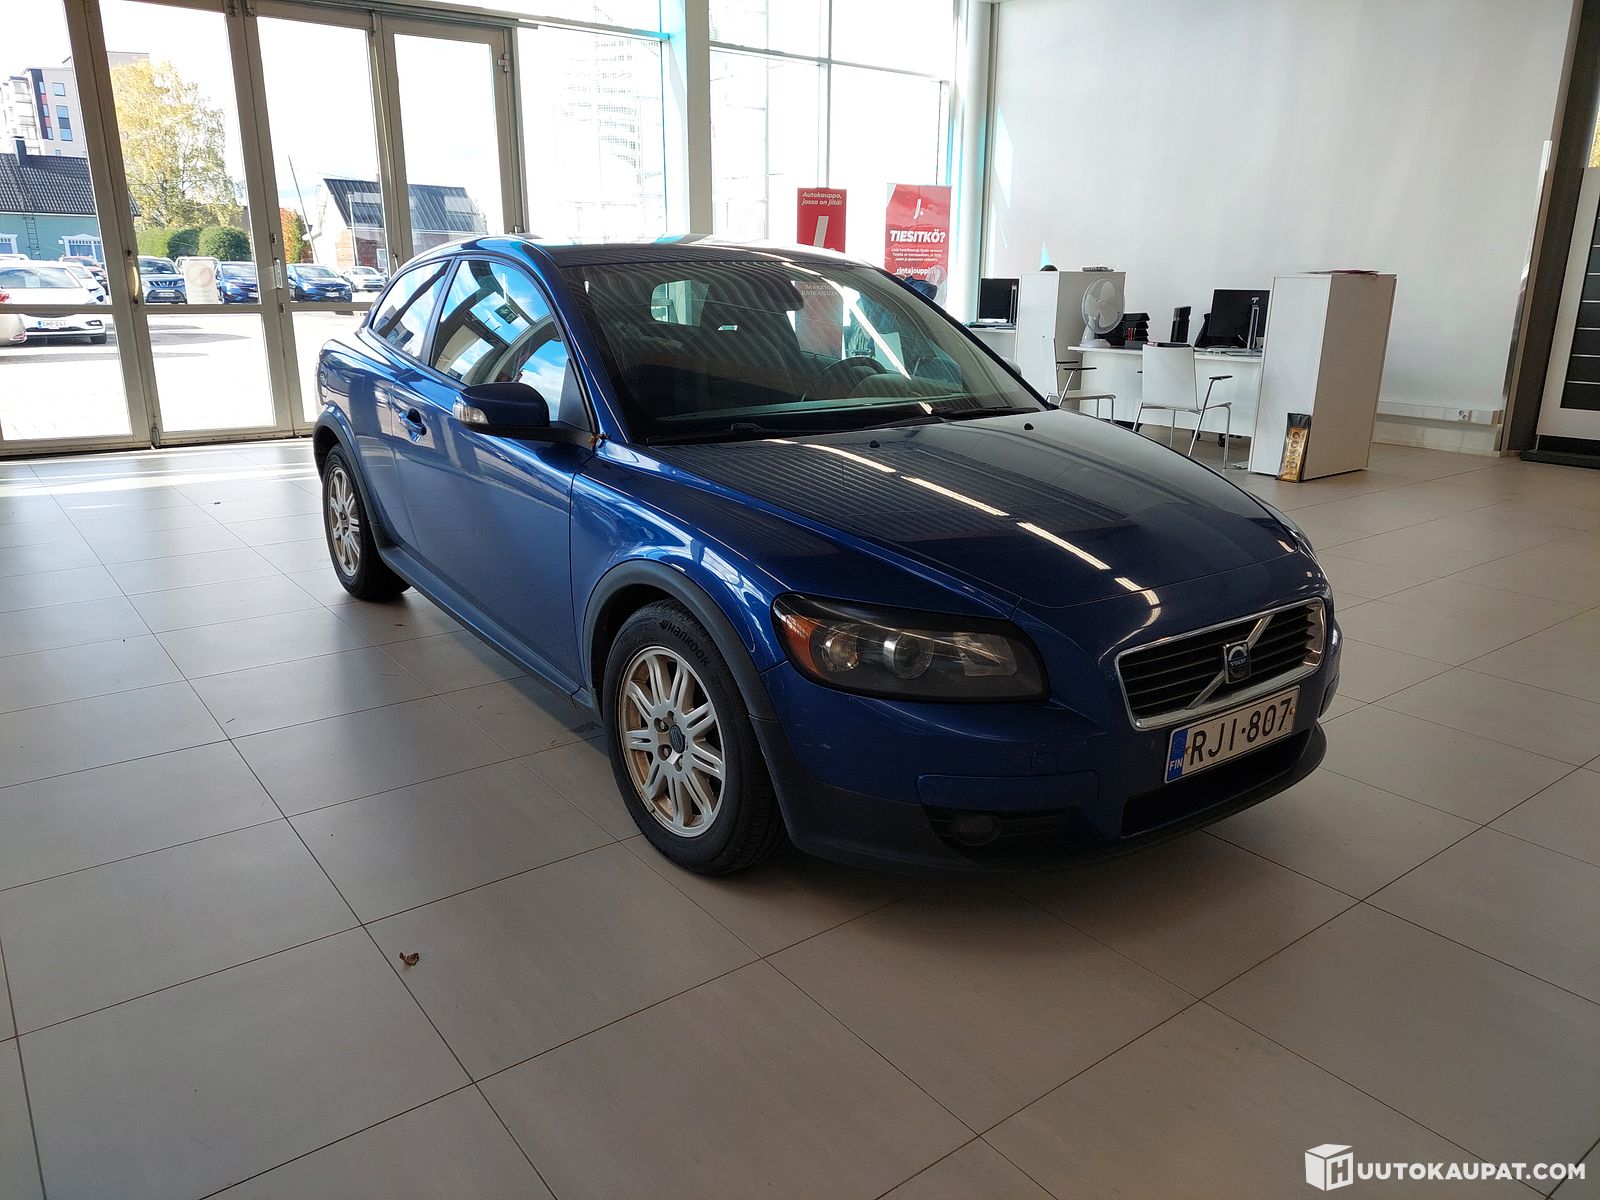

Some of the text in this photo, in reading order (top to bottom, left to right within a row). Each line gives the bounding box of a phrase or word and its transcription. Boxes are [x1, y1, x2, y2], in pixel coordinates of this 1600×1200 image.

[889, 228, 946, 243] TIESITKÖ?
[1189, 697, 1293, 766] RJI-807
[1169, 757, 1184, 771] FIN
